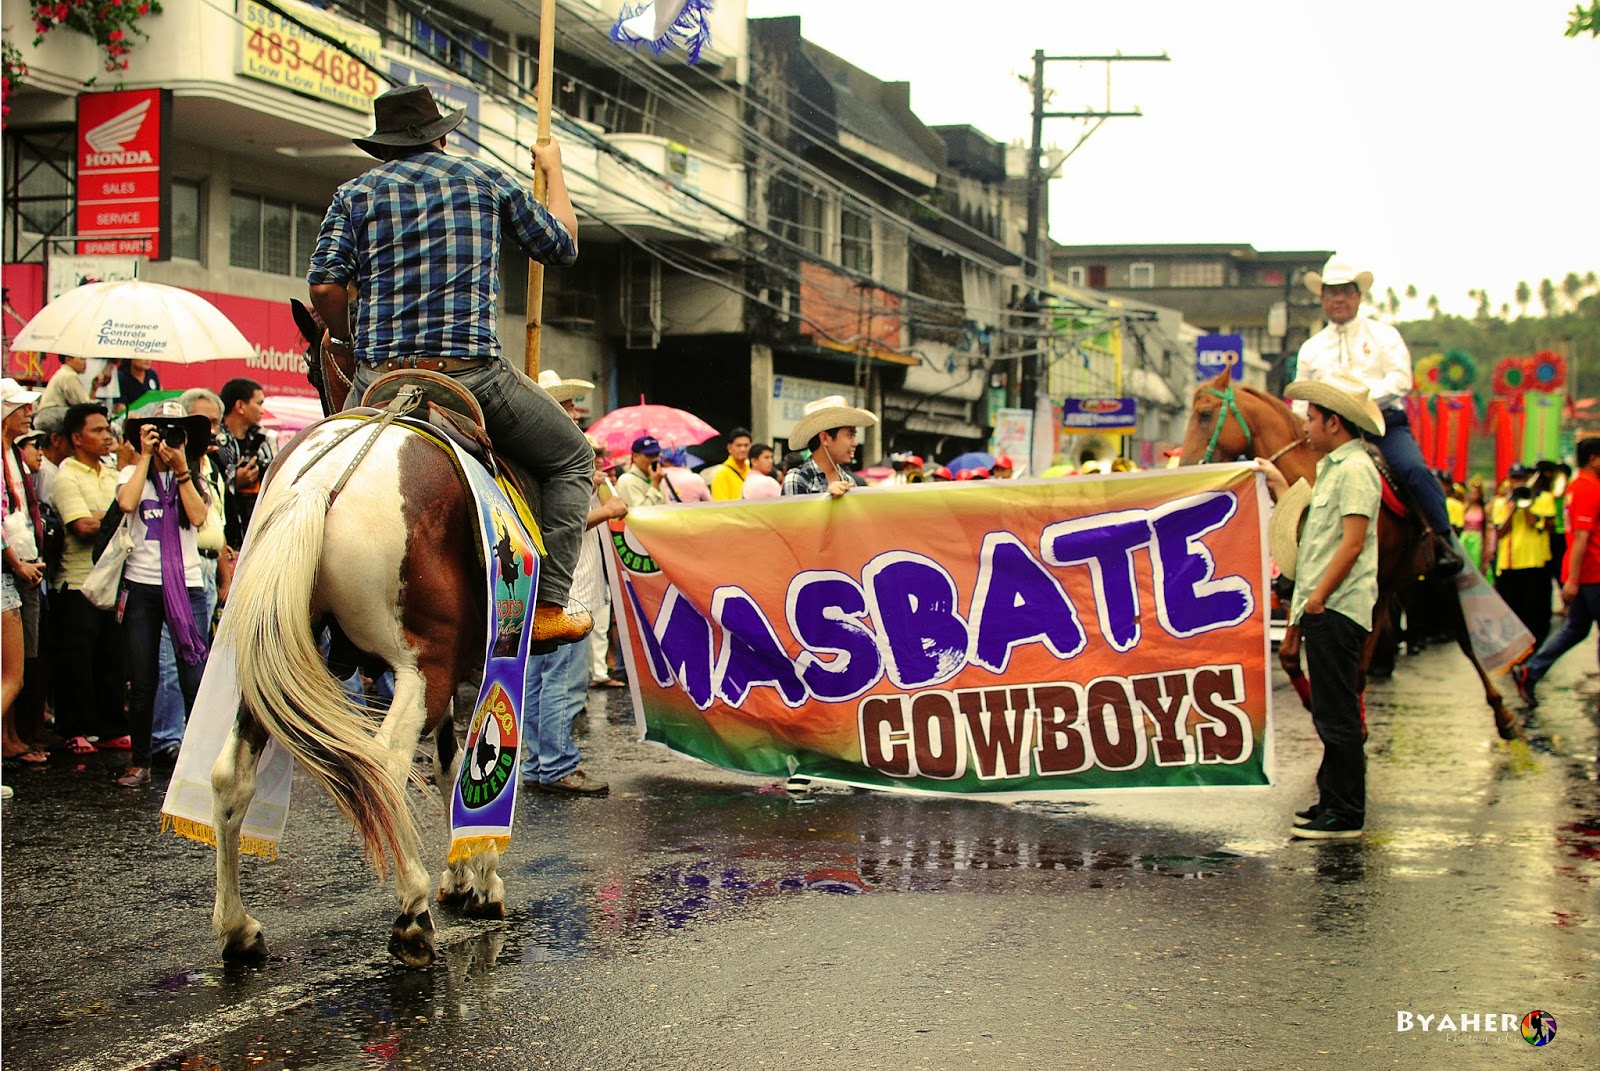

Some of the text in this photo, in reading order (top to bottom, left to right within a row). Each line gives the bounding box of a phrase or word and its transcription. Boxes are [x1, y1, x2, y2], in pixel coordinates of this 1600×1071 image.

[247, 5, 275, 28] SSS
[248, 27, 378, 96] 483-4685
[249, 59, 373, 108] Low Low Interest
[85, 150, 153, 167] HONDA
[102, 182, 135, 195] SALES
[96, 211, 140, 225] SERVICE
[84, 240, 153, 254] SPARE PARTS
[102, 319, 159, 330] Assurance
[100, 327, 146, 338] Controls
[97, 335, 167, 349] Technologies
[621, 491, 1255, 711] MASBATE
[857, 664, 1253, 781] COWBOYS
